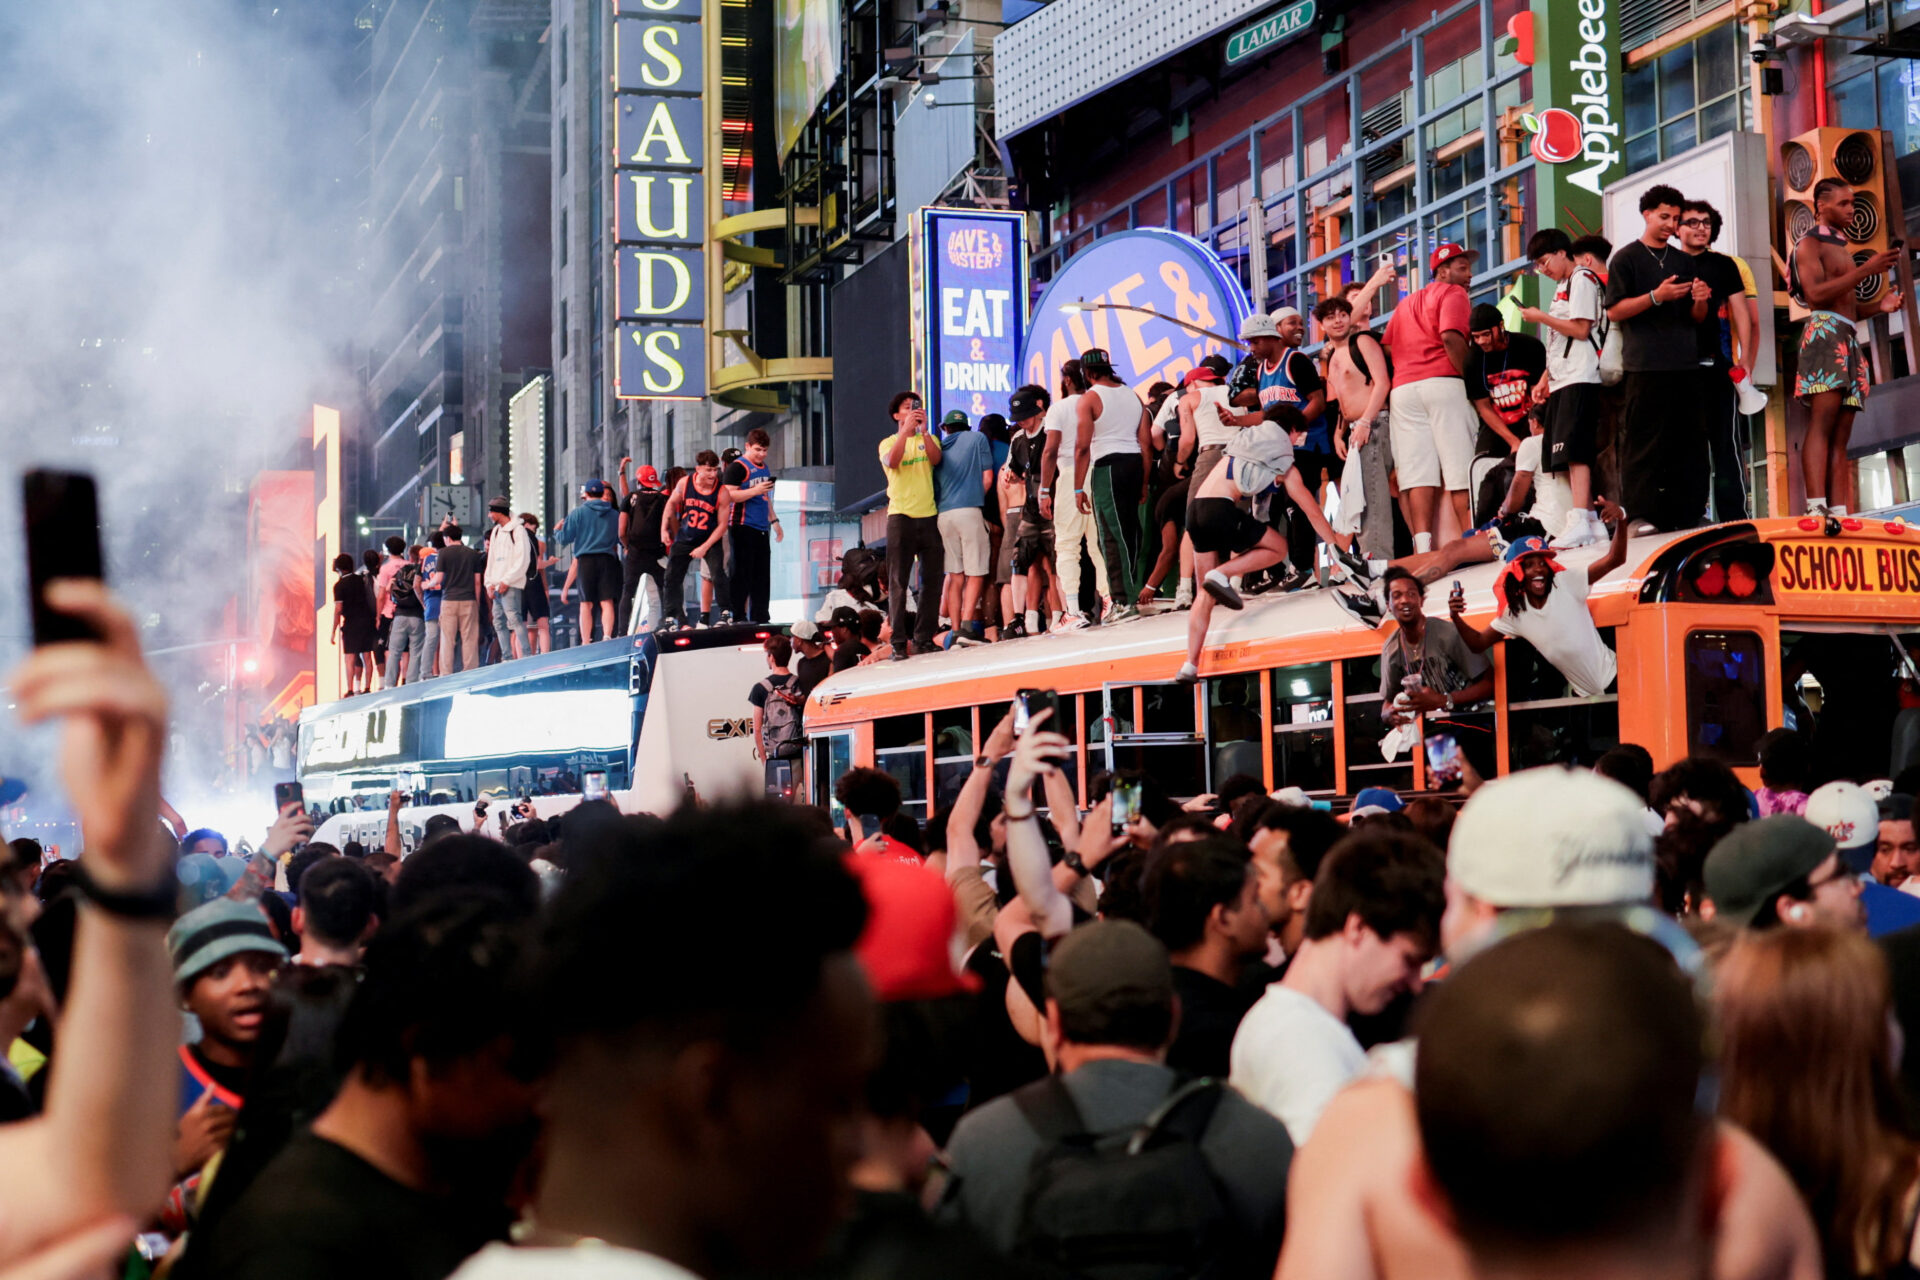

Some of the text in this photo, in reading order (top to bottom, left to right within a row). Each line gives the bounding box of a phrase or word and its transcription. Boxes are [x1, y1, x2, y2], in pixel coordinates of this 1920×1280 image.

[1239, 7, 1302, 55] LAMAR
[631, 0, 693, 393] SAUD'S
[991, 232, 1003, 253] &
[943, 287, 1009, 337] EAT
[1159, 261, 1217, 338] &
[970, 338, 985, 361] &
[944, 361, 1011, 392] DRINK
[971, 392, 986, 416] &
[688, 509, 709, 530] 32
[1780, 544, 1920, 592] SCHOOL BUS
